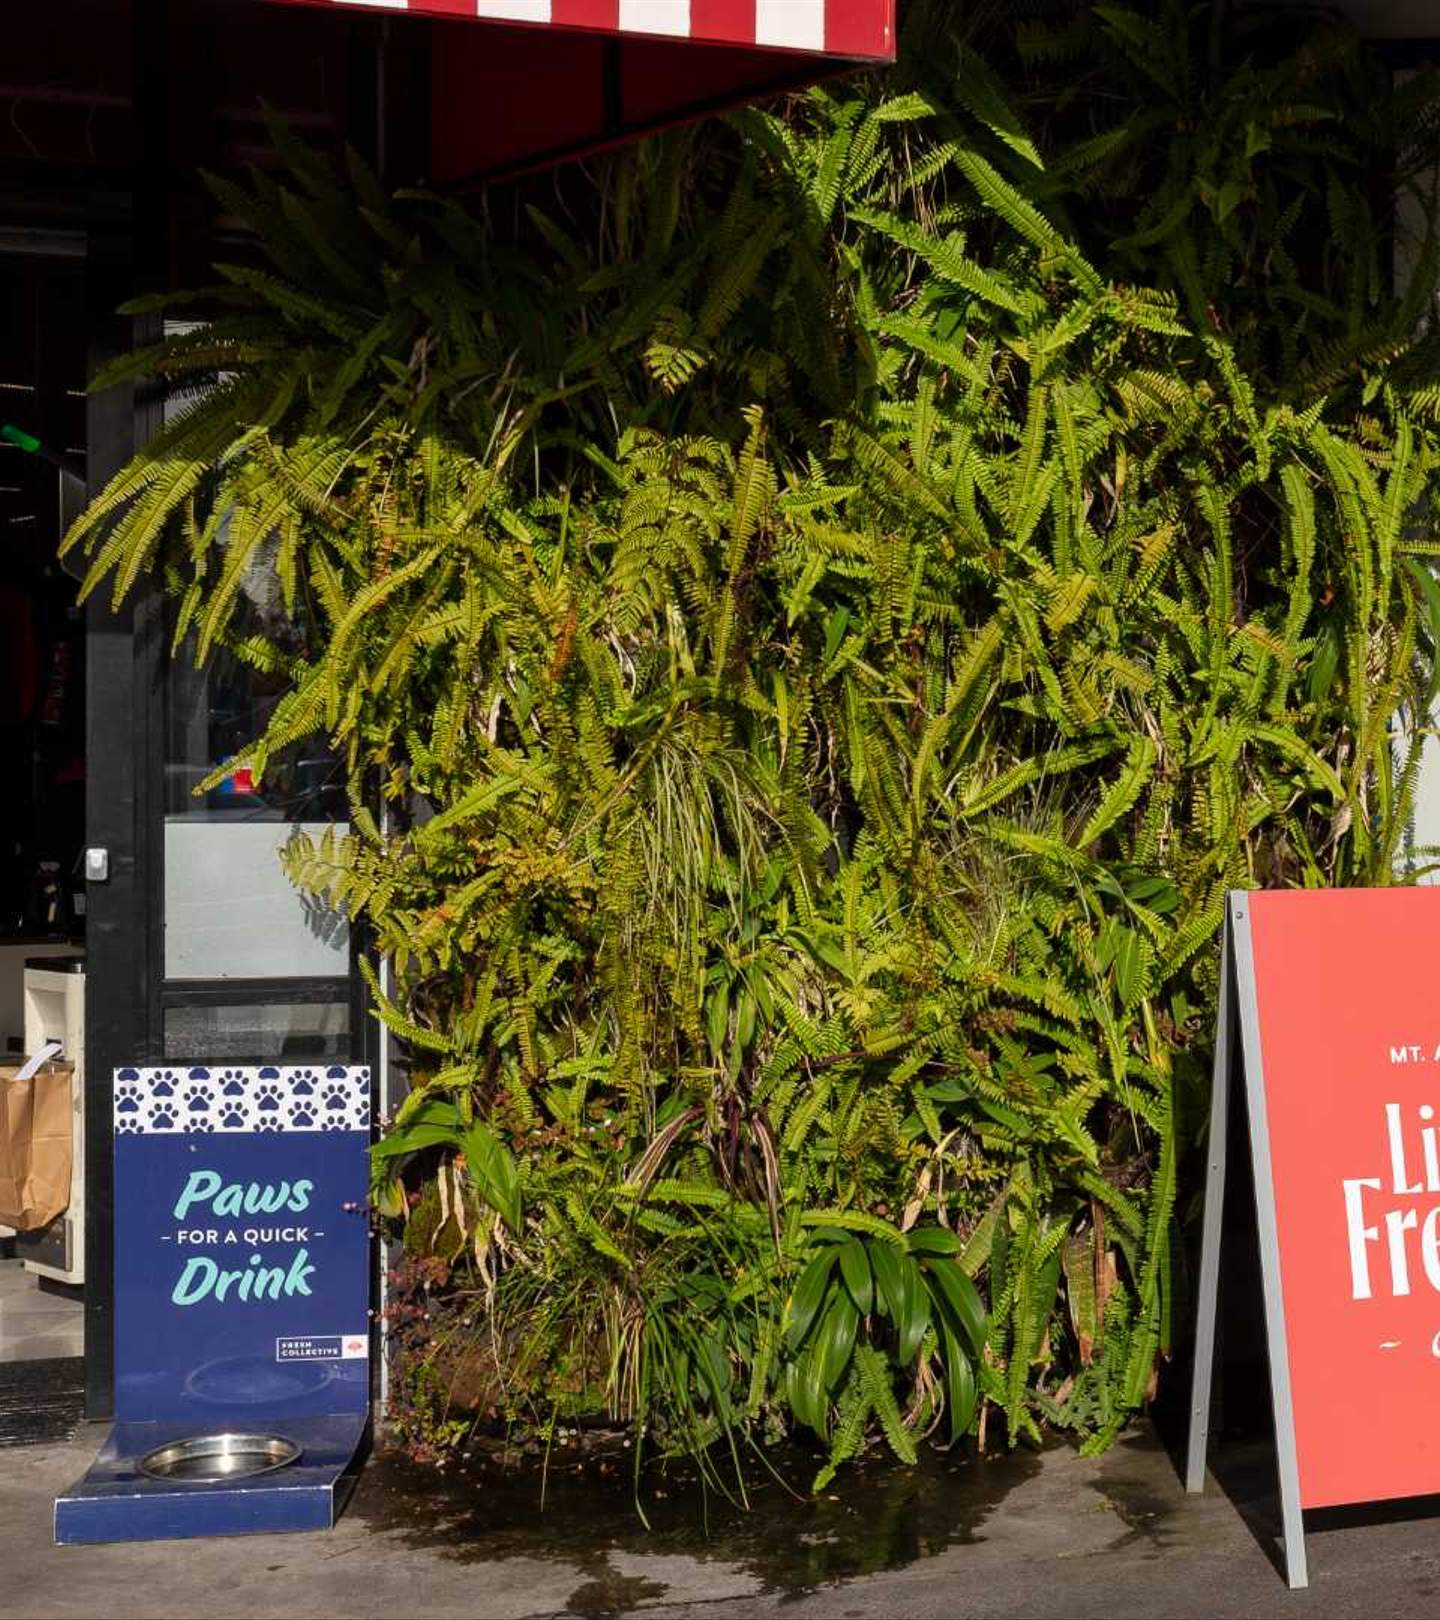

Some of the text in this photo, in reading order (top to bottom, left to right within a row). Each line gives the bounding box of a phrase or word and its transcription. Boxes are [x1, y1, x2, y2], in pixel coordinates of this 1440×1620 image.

[1389, 1045, 1426, 1064] MT.
[173, 1170, 315, 1222] Paws
[177, 1227, 309, 1245] FOR A QUICK
[171, 1248, 317, 1307] Drink
[281, 1348, 339, 1357] COLLECTIVE
